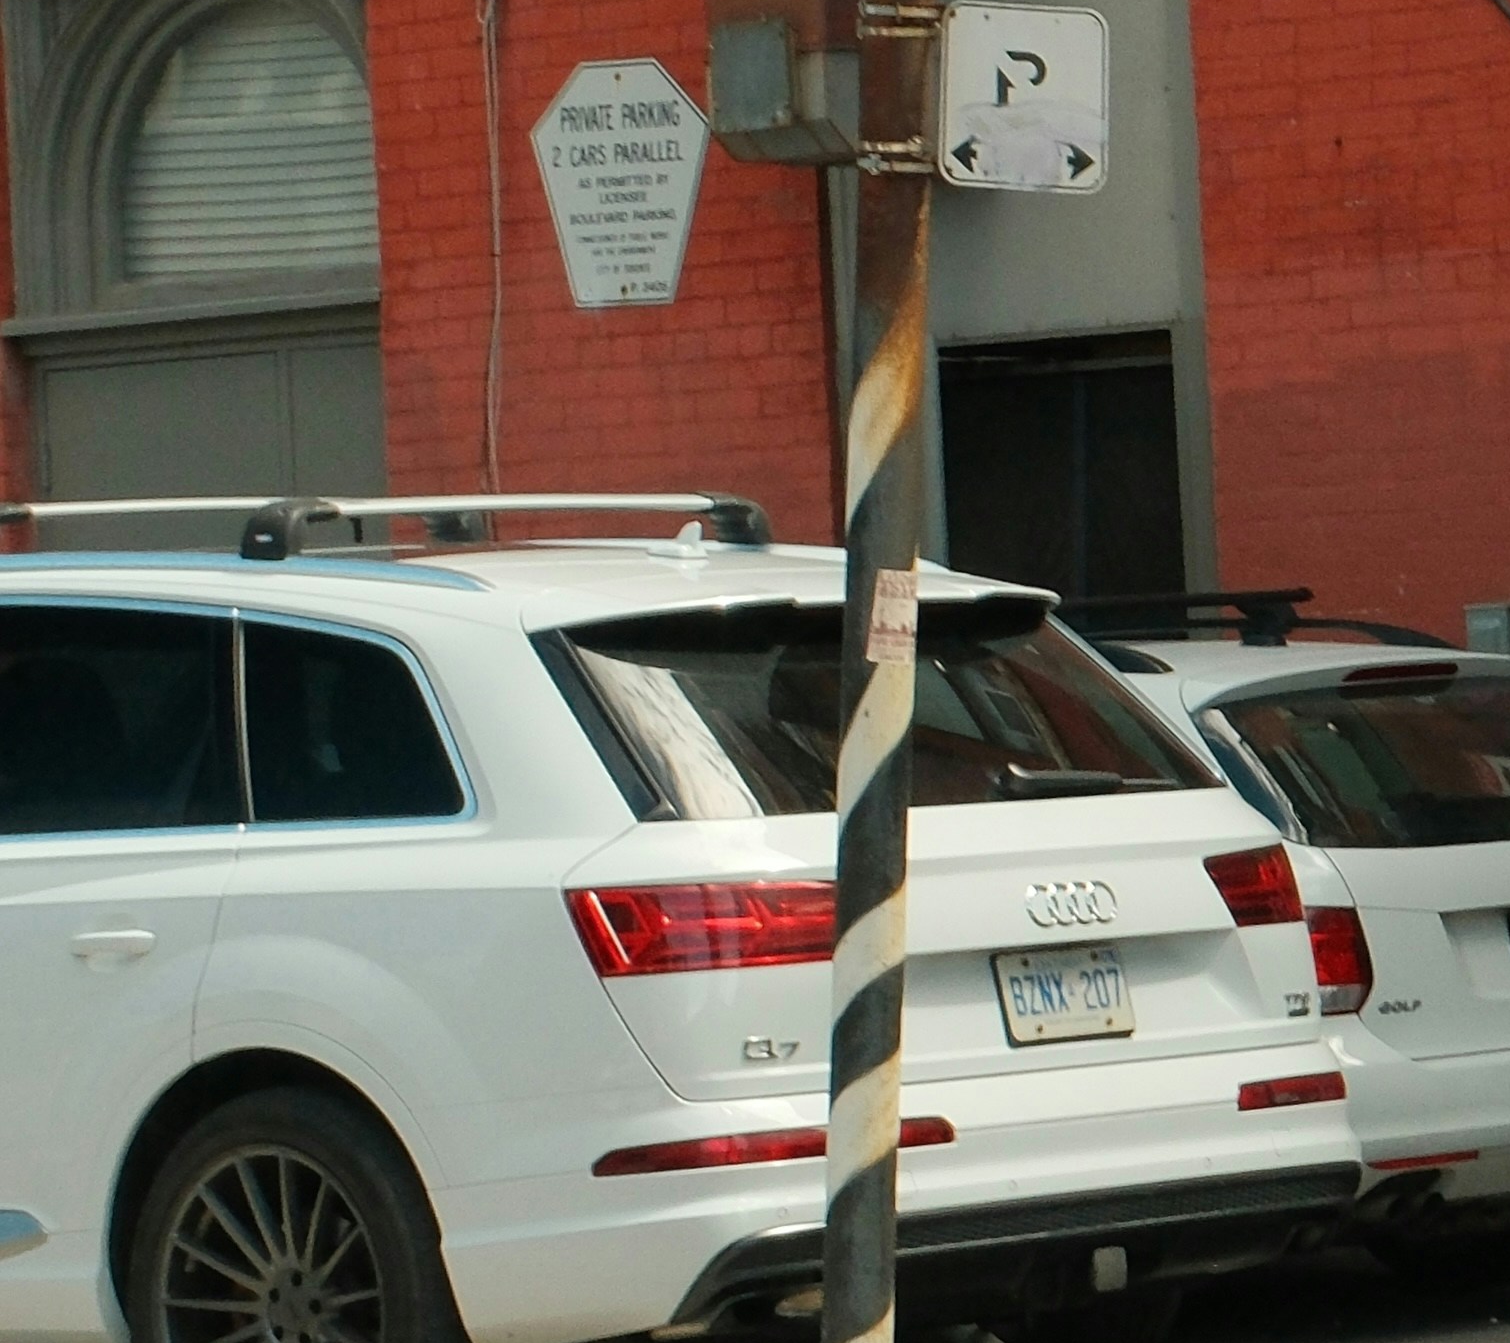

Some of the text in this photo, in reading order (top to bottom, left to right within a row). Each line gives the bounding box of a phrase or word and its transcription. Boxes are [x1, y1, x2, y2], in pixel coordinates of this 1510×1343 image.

[560, 99, 680, 133] PRIVATE PARKING
[552, 139, 684, 168] 2 CARS PARALLEL
[743, 1036, 801, 1061] Q7
